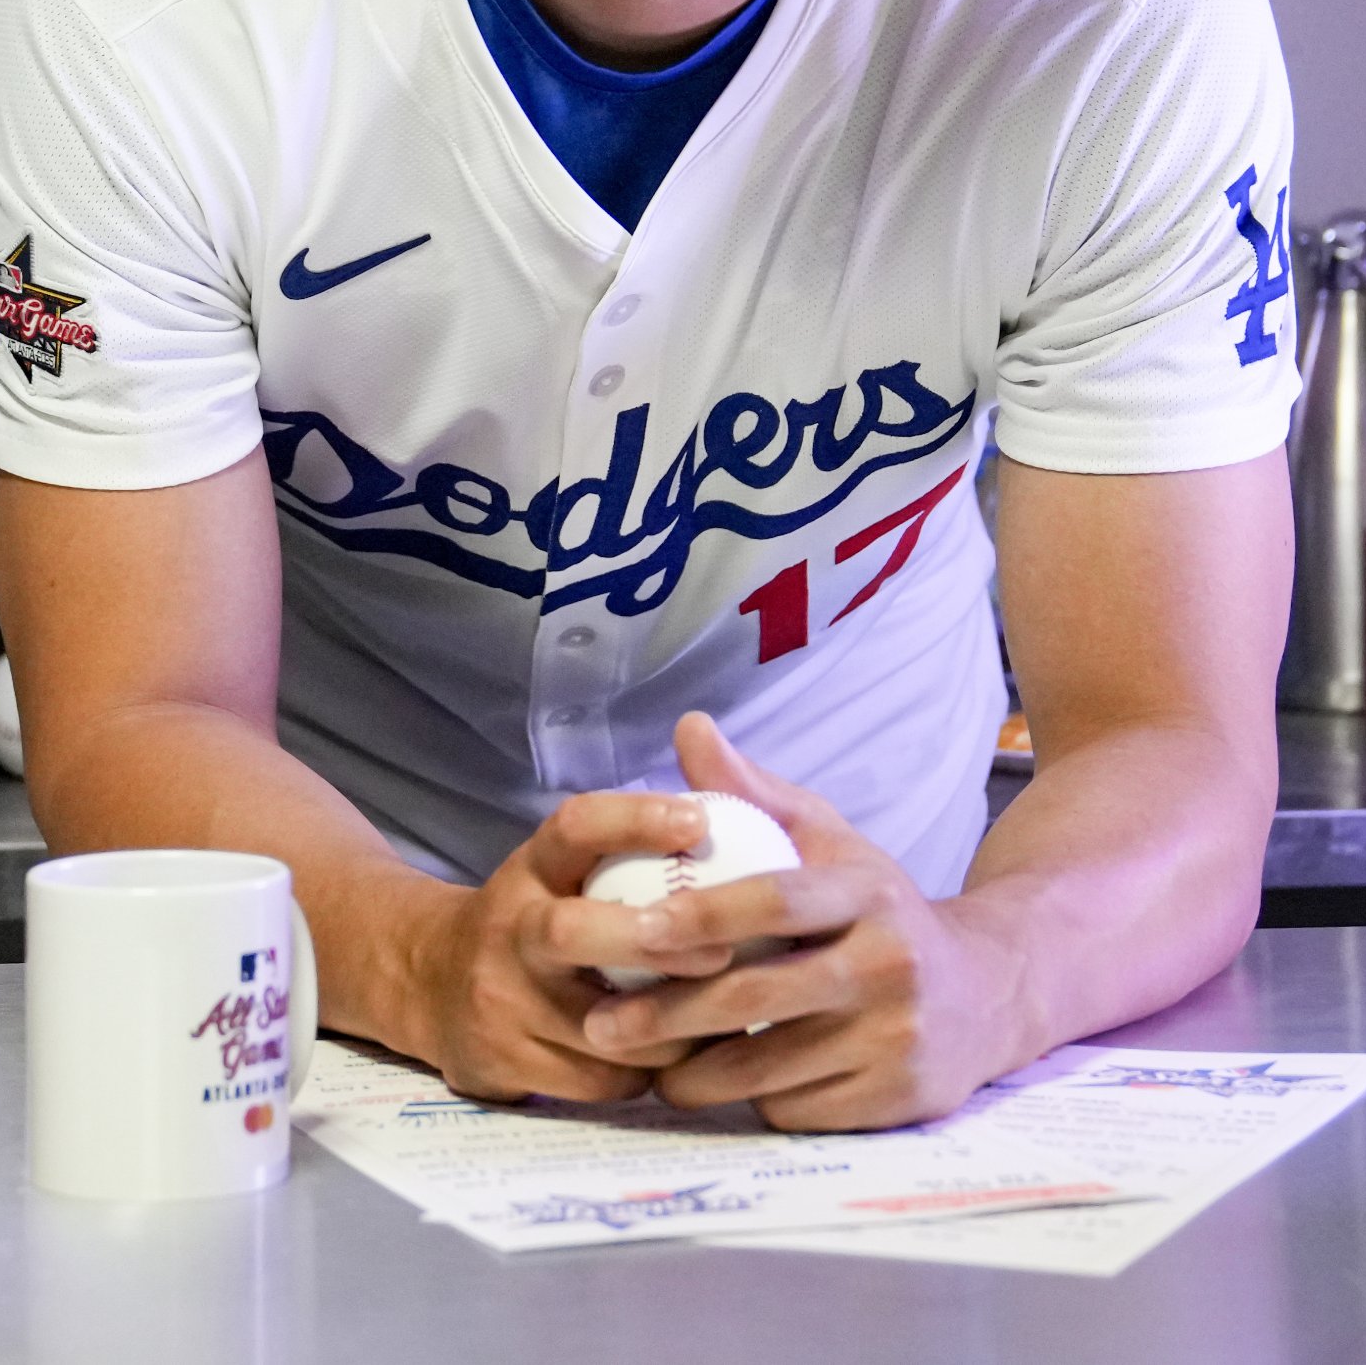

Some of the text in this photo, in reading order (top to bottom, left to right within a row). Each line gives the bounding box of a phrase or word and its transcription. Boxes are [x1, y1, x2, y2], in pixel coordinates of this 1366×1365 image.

[17, 296, 97, 352] Game
[261, 359, 977, 618] Dodgers
[738, 462, 968, 666] 17
[191, 992, 255, 1038] All
